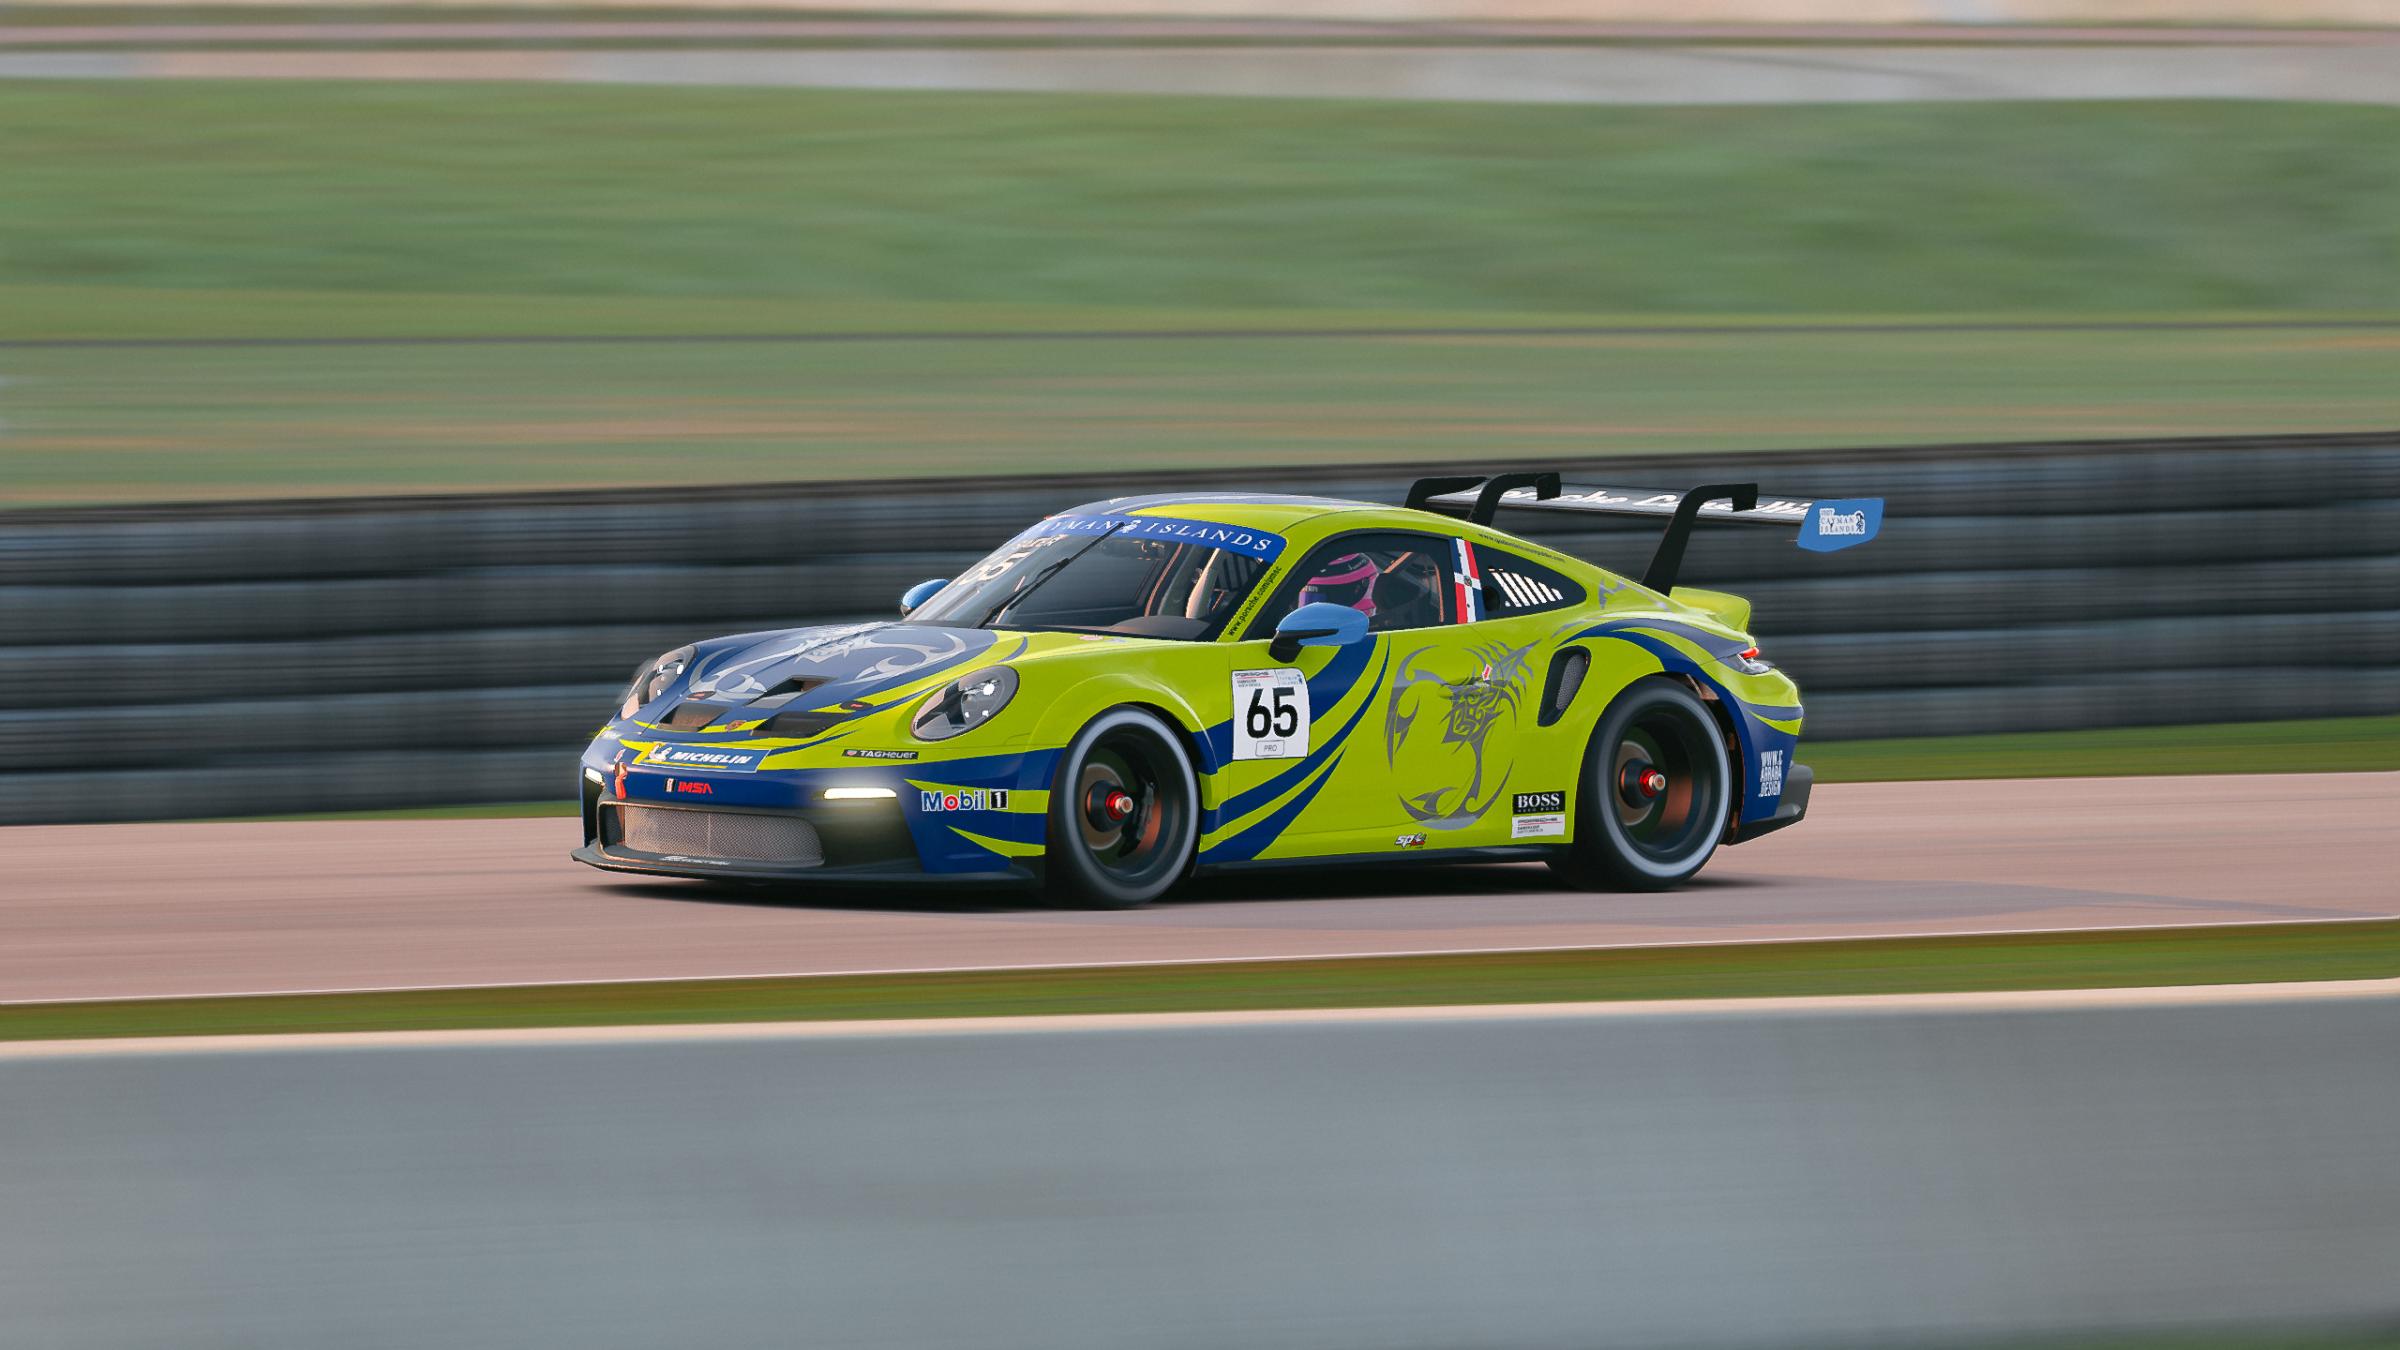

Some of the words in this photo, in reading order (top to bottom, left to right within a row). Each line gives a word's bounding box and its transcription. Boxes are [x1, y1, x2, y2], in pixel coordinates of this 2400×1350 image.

[1820, 516, 1856, 525] CAYMAN
[1820, 525, 1855, 533] ISLANDS
[1143, 522, 1273, 551] ISLANDS
[1246, 686, 1298, 739] 65
[1263, 744, 1278, 752] PRO
[669, 751, 753, 764] MICHELIN
[677, 781, 713, 794] IMSA
[921, 789, 987, 812] Mobil
[1517, 793, 1561, 808] BOSS
